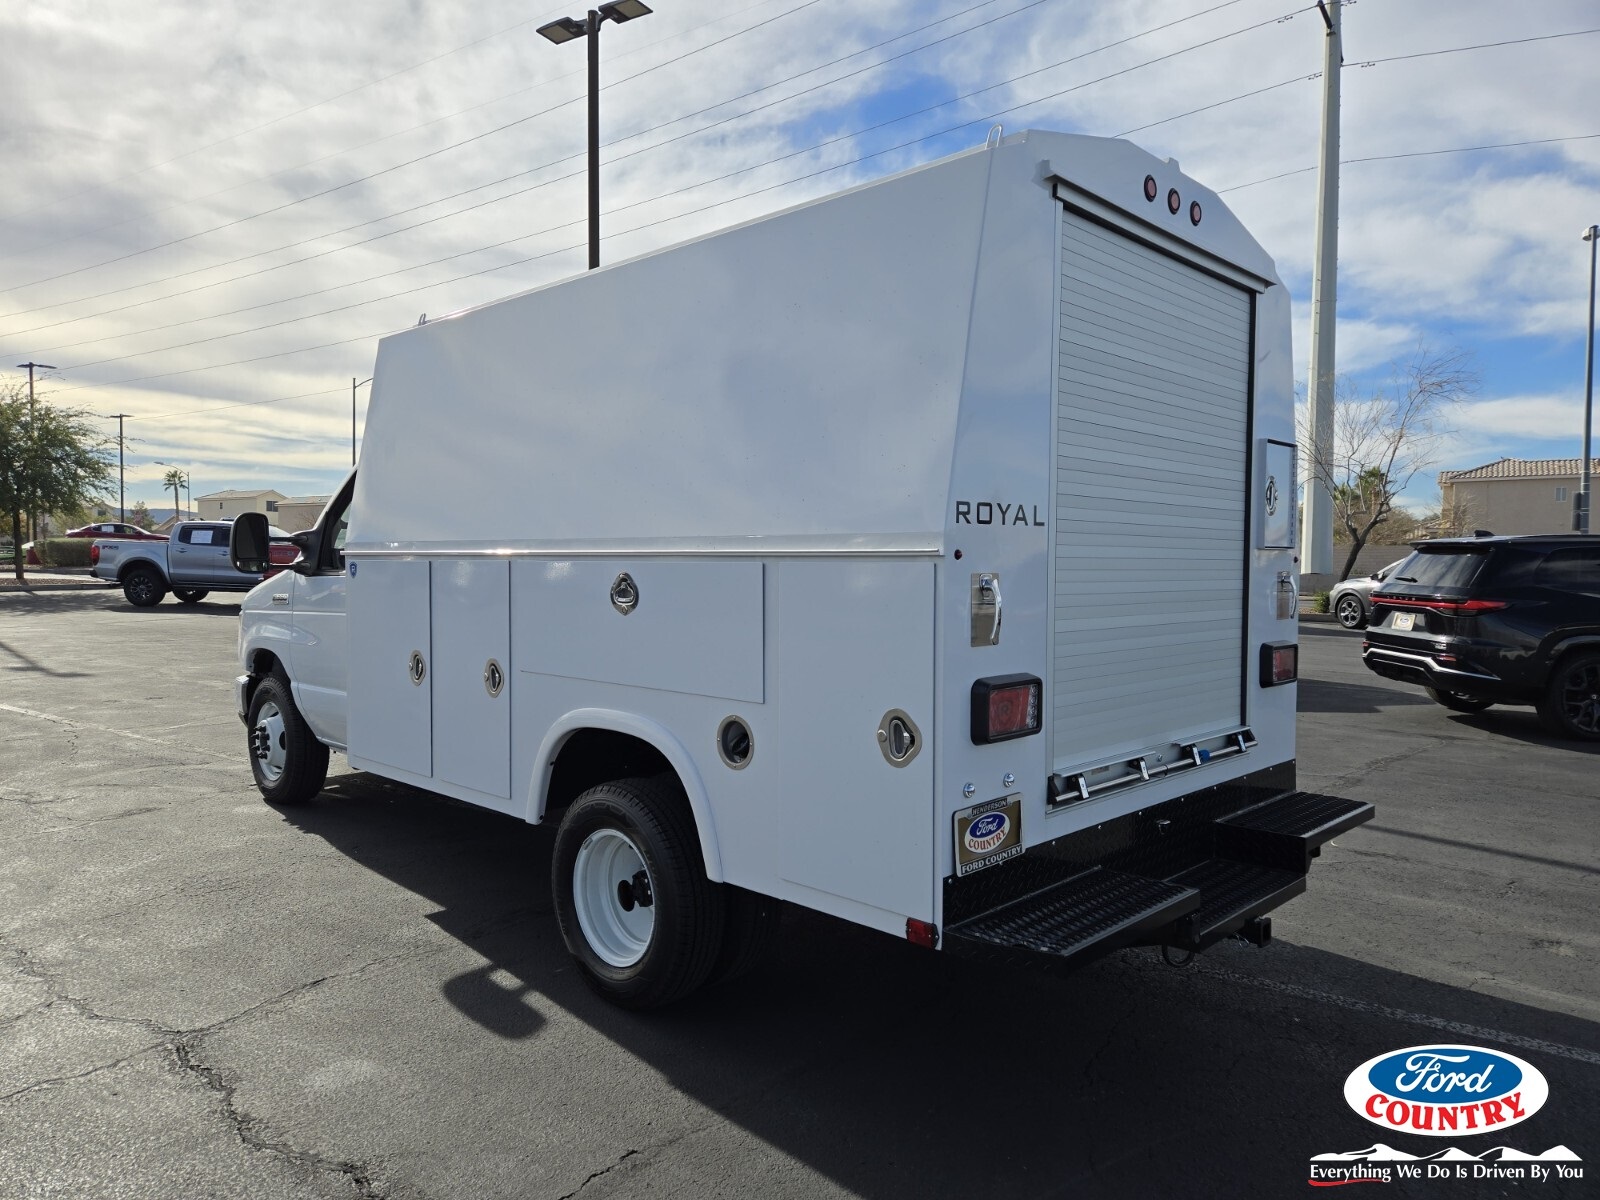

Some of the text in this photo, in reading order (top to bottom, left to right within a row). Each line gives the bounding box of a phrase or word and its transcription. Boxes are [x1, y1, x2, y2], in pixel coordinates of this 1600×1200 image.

[955, 500, 1045, 527] ROYAL
[972, 799, 1007, 816] HENDERSON
[976, 817, 999, 836] Ford
[968, 827, 1007, 851] COUNTRY
[961, 845, 1022, 874] FORD COUNTRY
